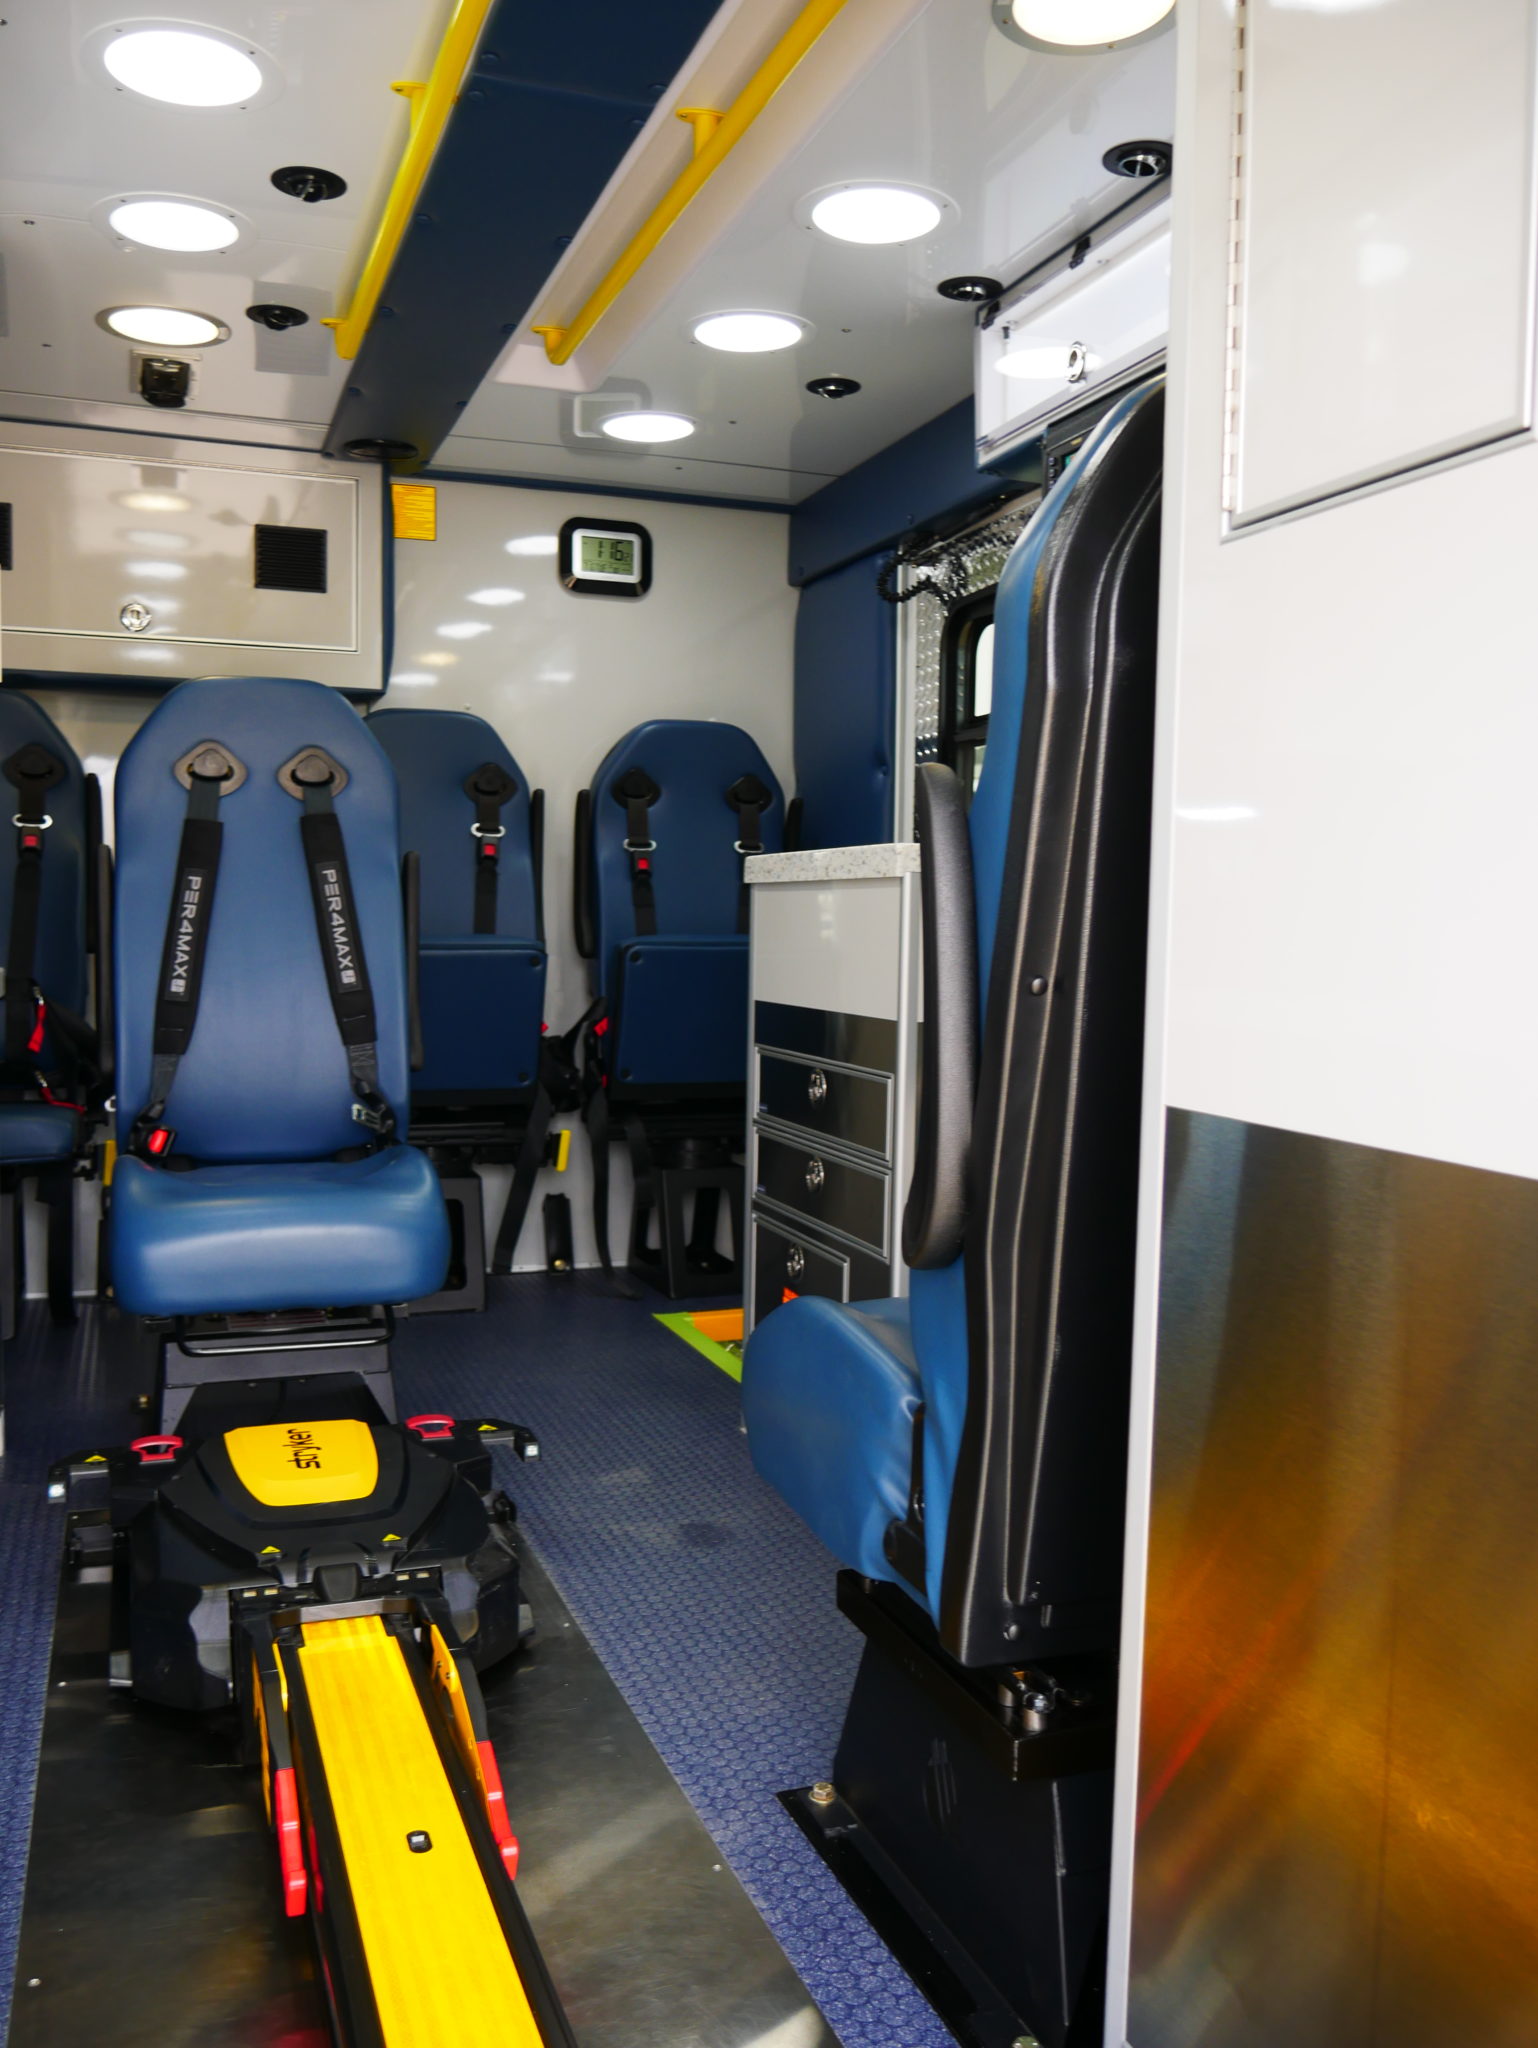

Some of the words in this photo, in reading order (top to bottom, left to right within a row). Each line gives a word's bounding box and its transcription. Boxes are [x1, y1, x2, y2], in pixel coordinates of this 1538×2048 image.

[171, 876, 202, 977] PER4MAX
[322, 868, 353, 969] PER4MAX
[282, 1428, 322, 1469] stryker
